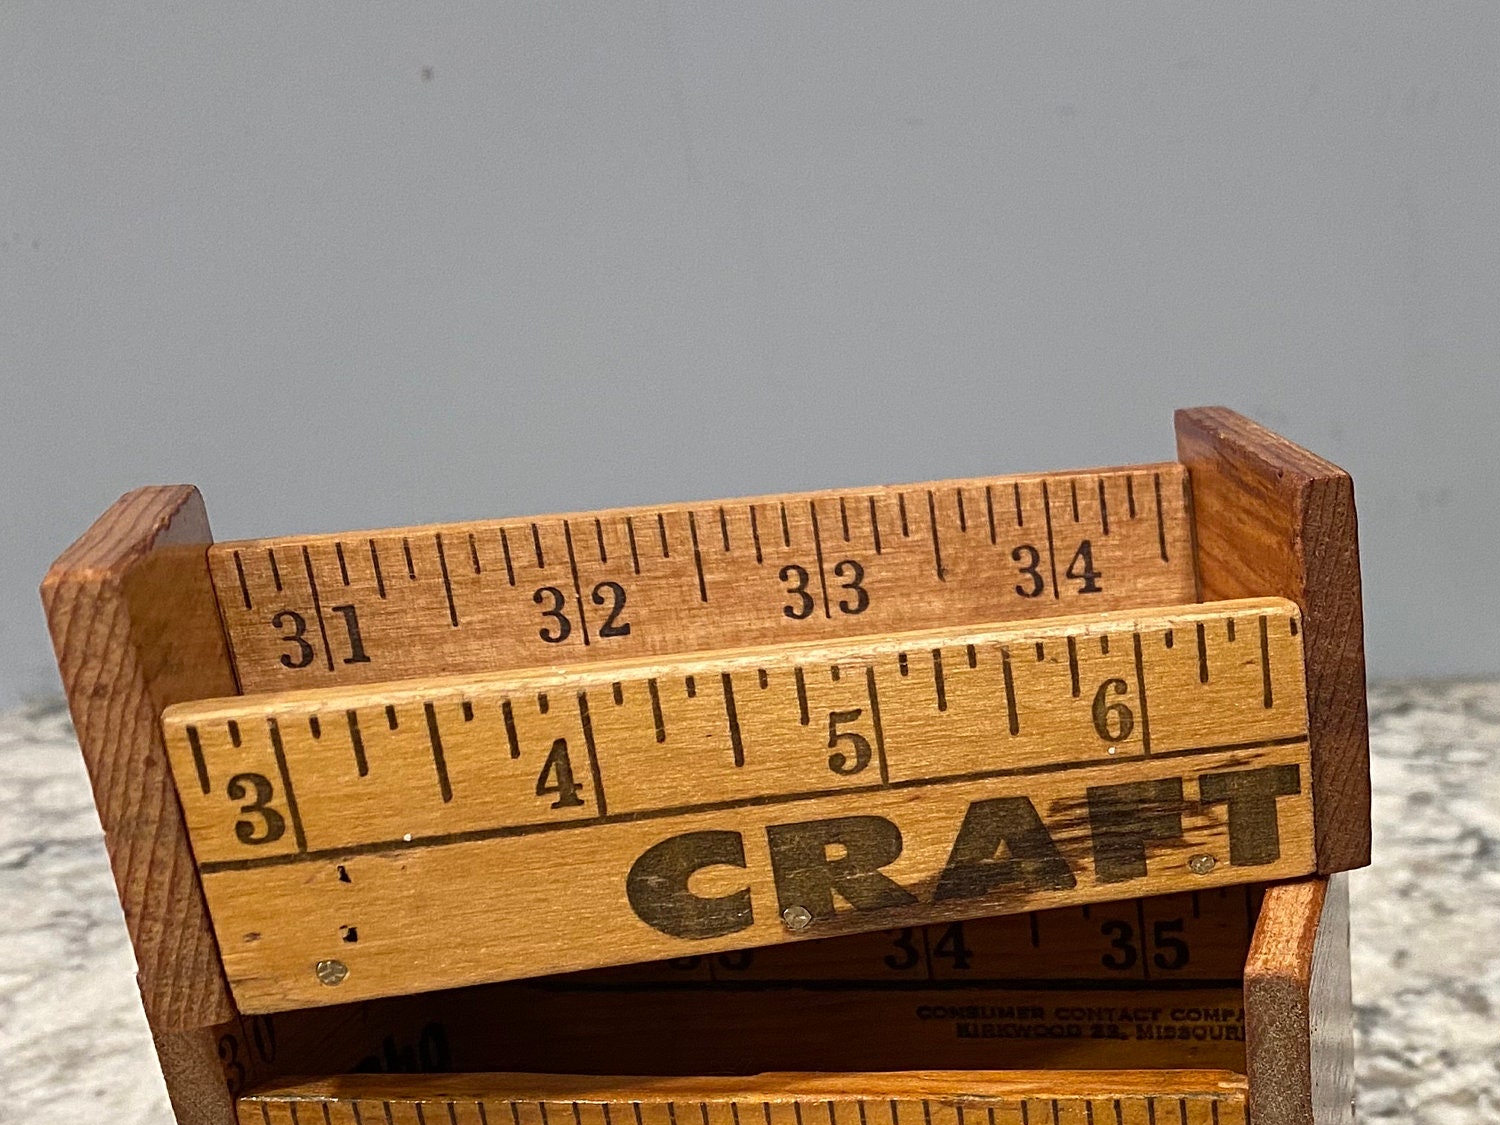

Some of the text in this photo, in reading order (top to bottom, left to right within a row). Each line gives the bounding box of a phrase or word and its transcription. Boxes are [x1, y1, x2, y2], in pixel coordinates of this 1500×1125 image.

[272, 539, 1102, 669] 31 32 33 34
[227, 678, 1135, 845] 3 4 5 6
[626, 763, 1301, 941] CRAFT
[1101, 919, 1191, 971] 35
[916, 1004, 1044, 1020] CONSUMER
[1054, 1005, 1162, 1022] CONTACT
[955, 1022, 1083, 1038] KIRKWOOD
